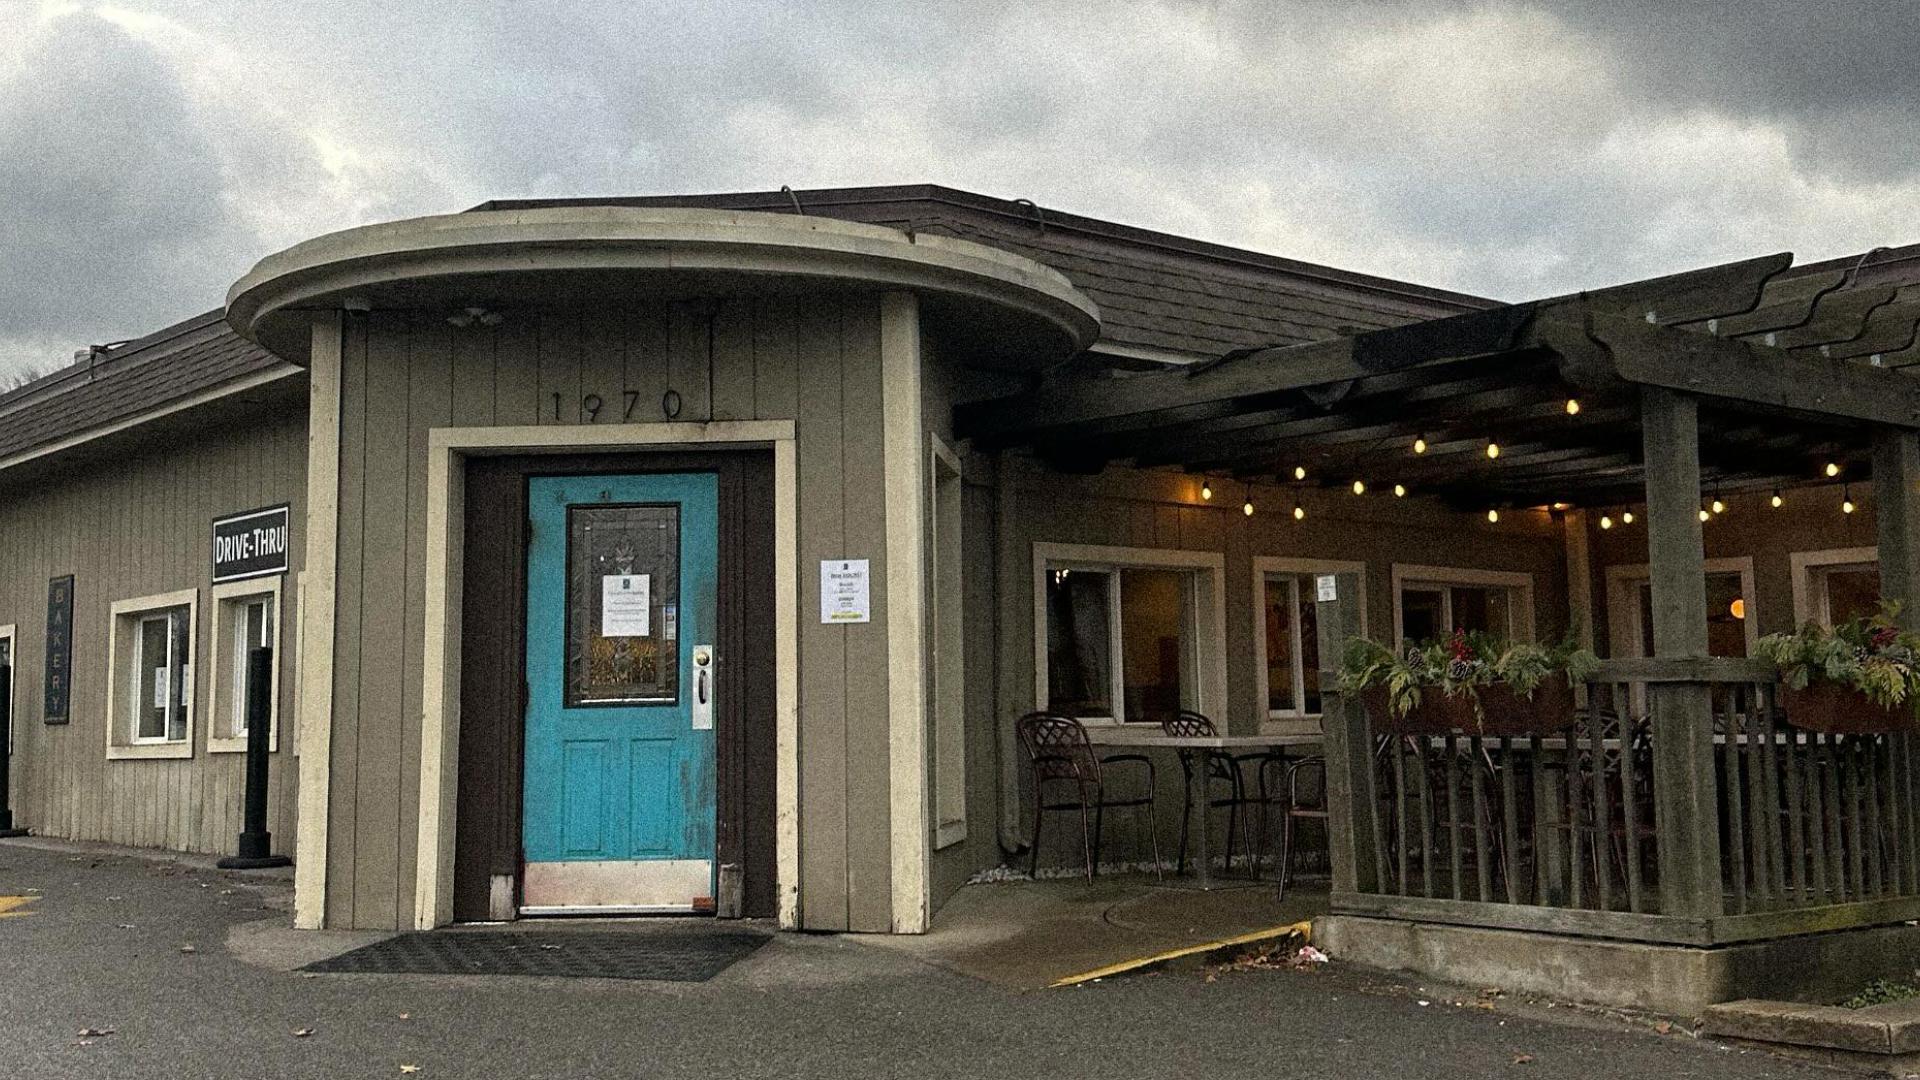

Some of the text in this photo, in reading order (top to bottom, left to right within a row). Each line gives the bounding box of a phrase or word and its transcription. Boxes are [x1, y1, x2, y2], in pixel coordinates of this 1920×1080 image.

[552, 390, 682, 422] 1970
[216, 525, 285, 564] DRIVE-THRU
[52, 588, 64, 710] BAKERY
